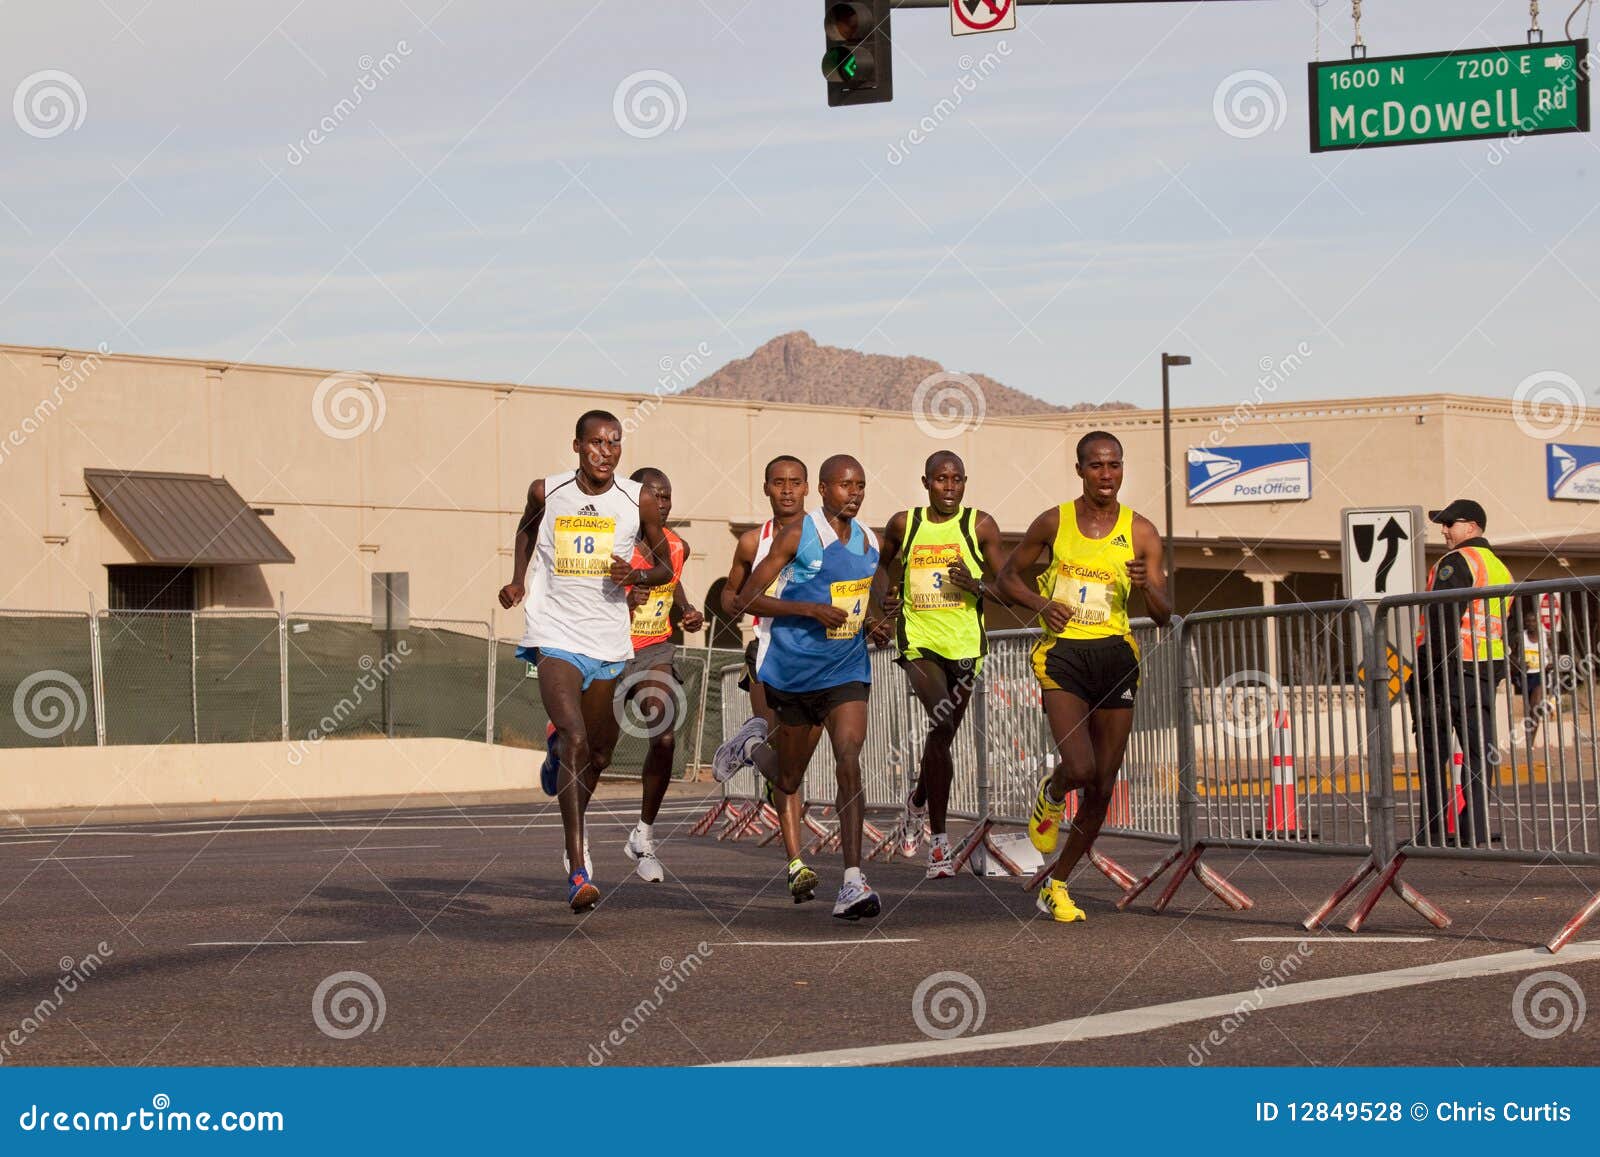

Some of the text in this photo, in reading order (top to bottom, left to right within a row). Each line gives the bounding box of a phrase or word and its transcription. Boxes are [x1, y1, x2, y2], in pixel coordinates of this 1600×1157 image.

[1457, 55, 1531, 79] 7200 E
[1330, 67, 1405, 90] 1600 N
[1330, 85, 1567, 140] McDowell Rd
[1234, 483, 1300, 495] Post Office
[573, 535, 595, 554] 18
[932, 571, 943, 589] 3
[1078, 585, 1087, 604] 1
[655, 600, 664, 617] 2
[853, 599, 861, 615] 4
